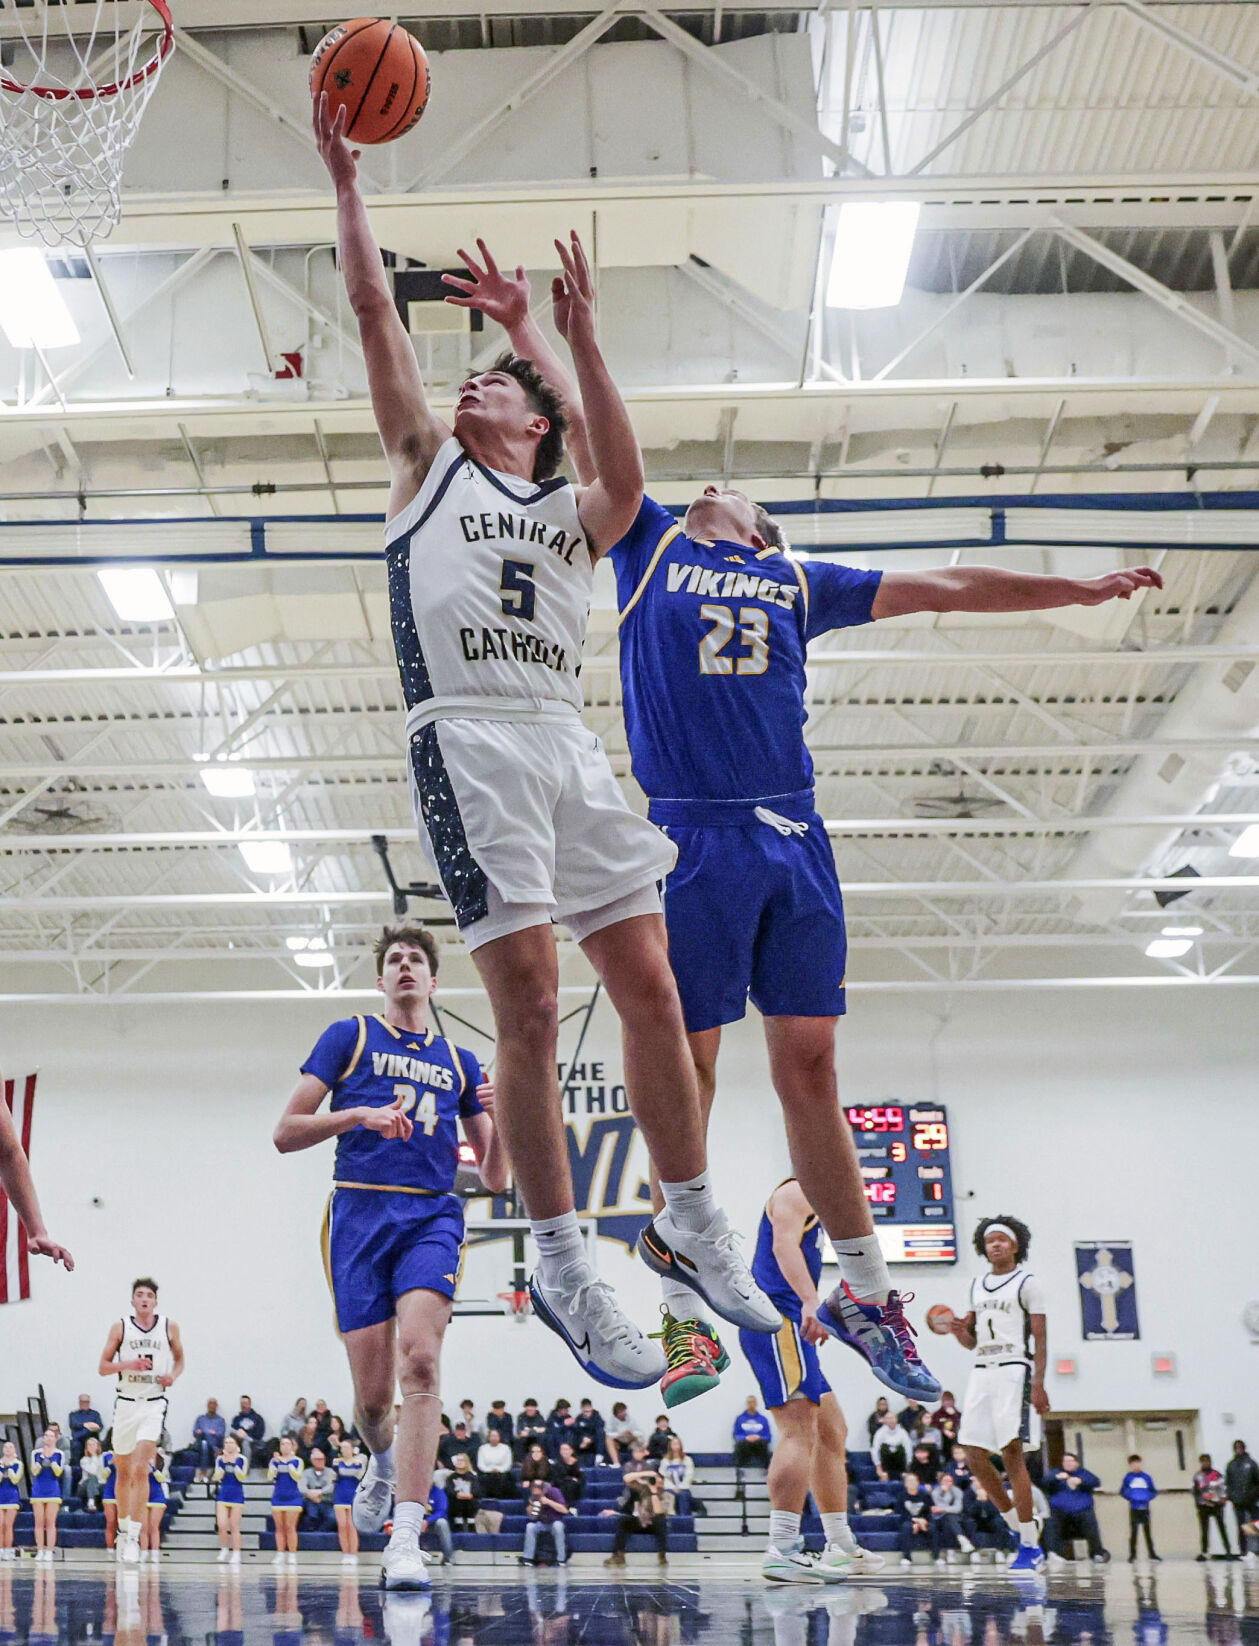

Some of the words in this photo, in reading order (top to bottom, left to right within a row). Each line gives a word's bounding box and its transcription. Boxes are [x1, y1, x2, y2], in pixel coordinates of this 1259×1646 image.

[500, 558, 536, 622] 5
[666, 562, 800, 611] VIKINGS
[698, 604, 770, 676] 23
[371, 1051, 454, 1092] VIKINGS
[556, 1062, 605, 1081] THE
[891, 1141, 907, 1163] 3
[913, 1123, 948, 1150] 29
[987, 1318, 995, 1340] 1
